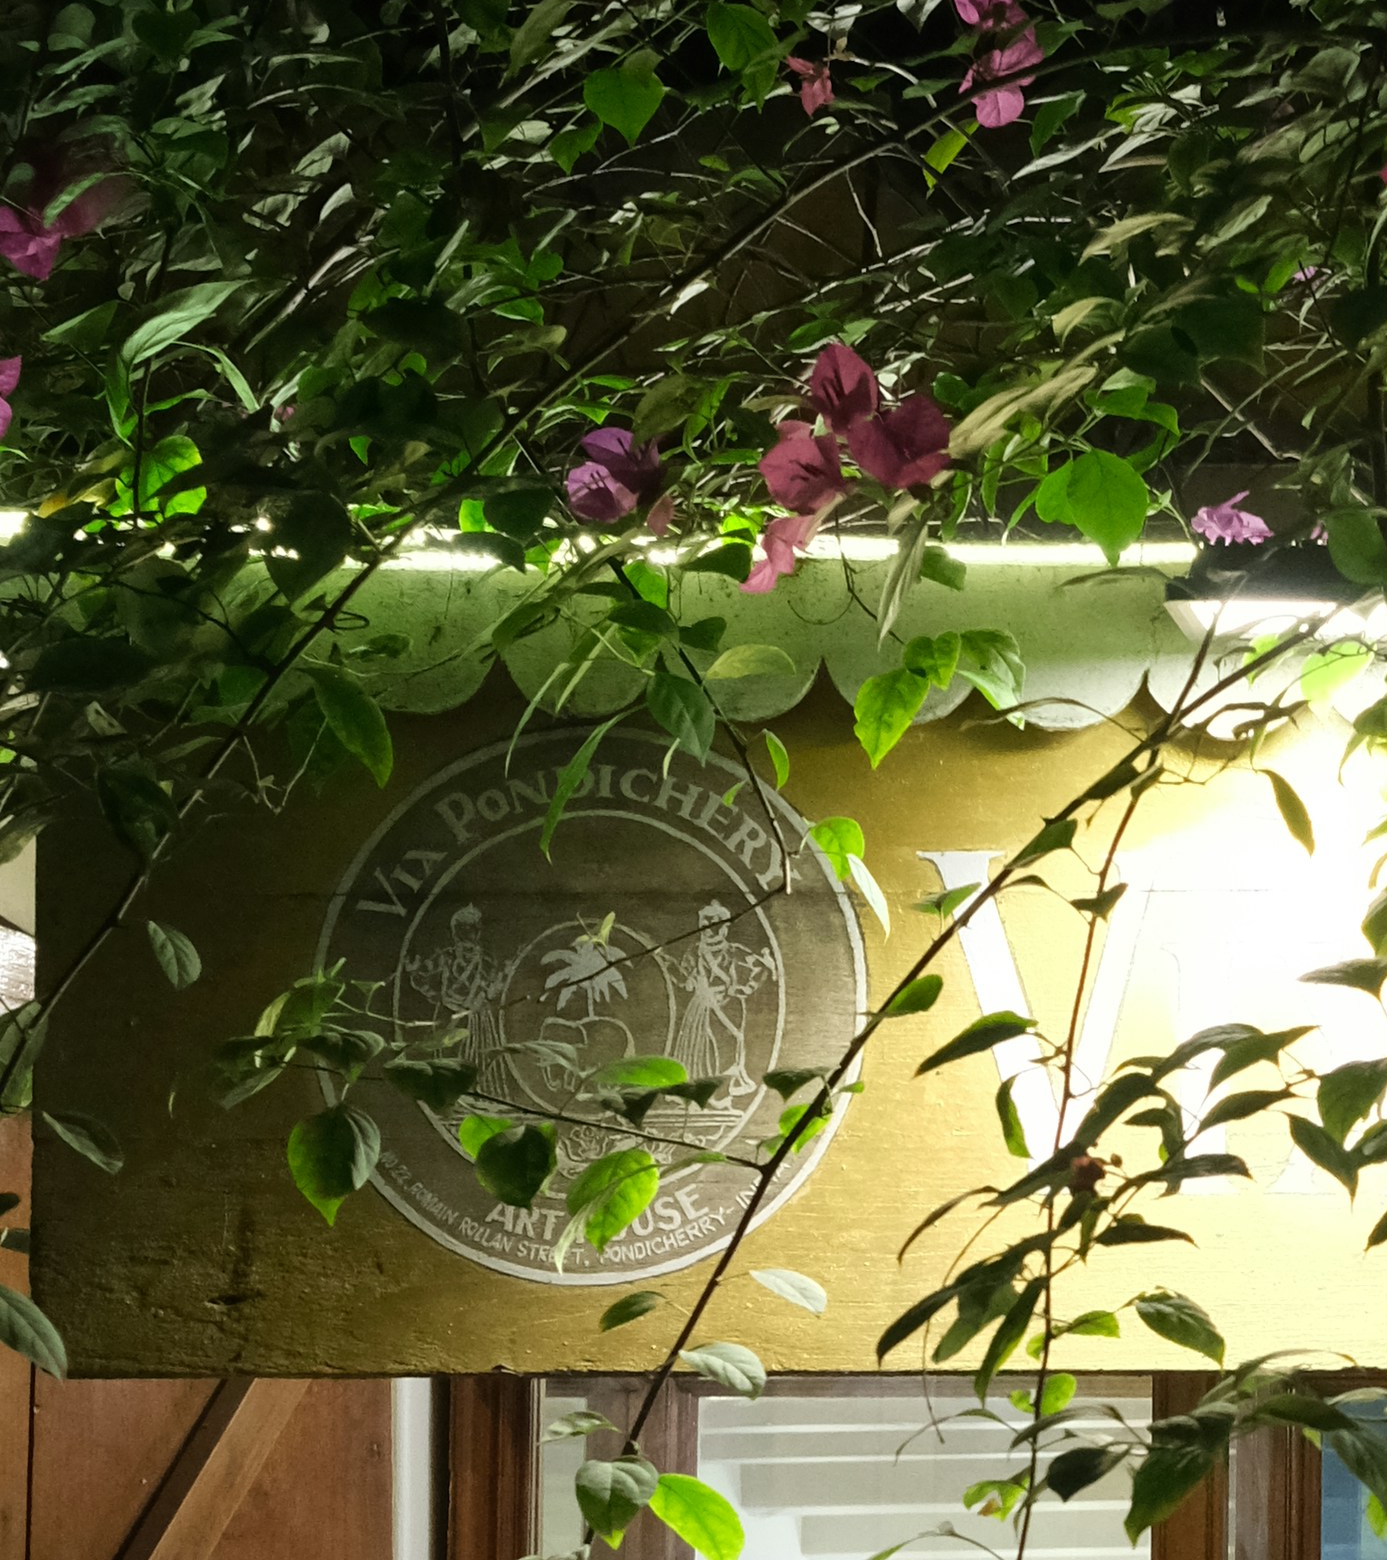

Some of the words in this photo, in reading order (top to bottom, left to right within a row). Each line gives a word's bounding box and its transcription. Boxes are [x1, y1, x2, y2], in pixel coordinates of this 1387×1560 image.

[356, 850, 448, 917] VIA
[434, 764, 802, 891] PONDICHERY
[484, 1203, 565, 1240] ART
[573, 1183, 709, 1244] USE
